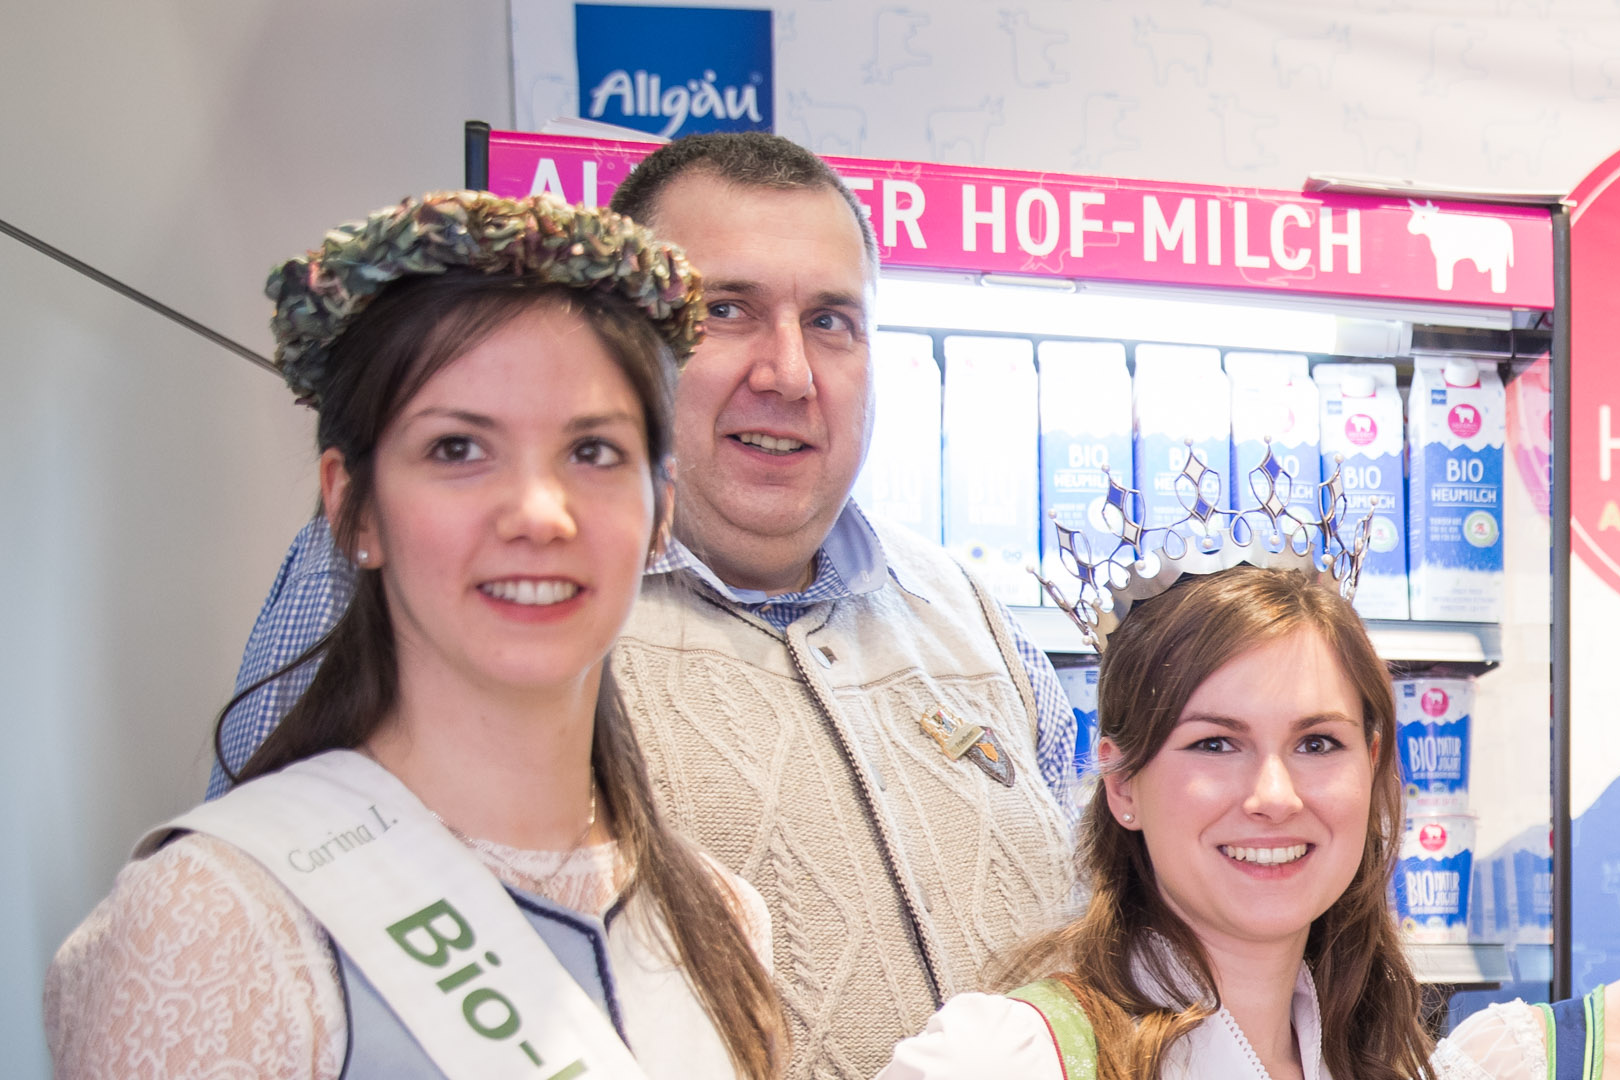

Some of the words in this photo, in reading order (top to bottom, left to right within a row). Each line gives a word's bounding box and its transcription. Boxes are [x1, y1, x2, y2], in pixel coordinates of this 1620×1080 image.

[589, 69, 764, 138] Allgäu
[961, 184, 1362, 275] HOF-MILCH
[1343, 464, 1382, 489] BIO
[1446, 458, 1484, 482] BIO
[1430, 487, 1497, 503] HEUMILCH
[1408, 735, 1437, 772] BIO
[287, 824, 377, 873] Carina
[367, 804, 398, 832] I.
[1405, 870, 1434, 906] BIO
